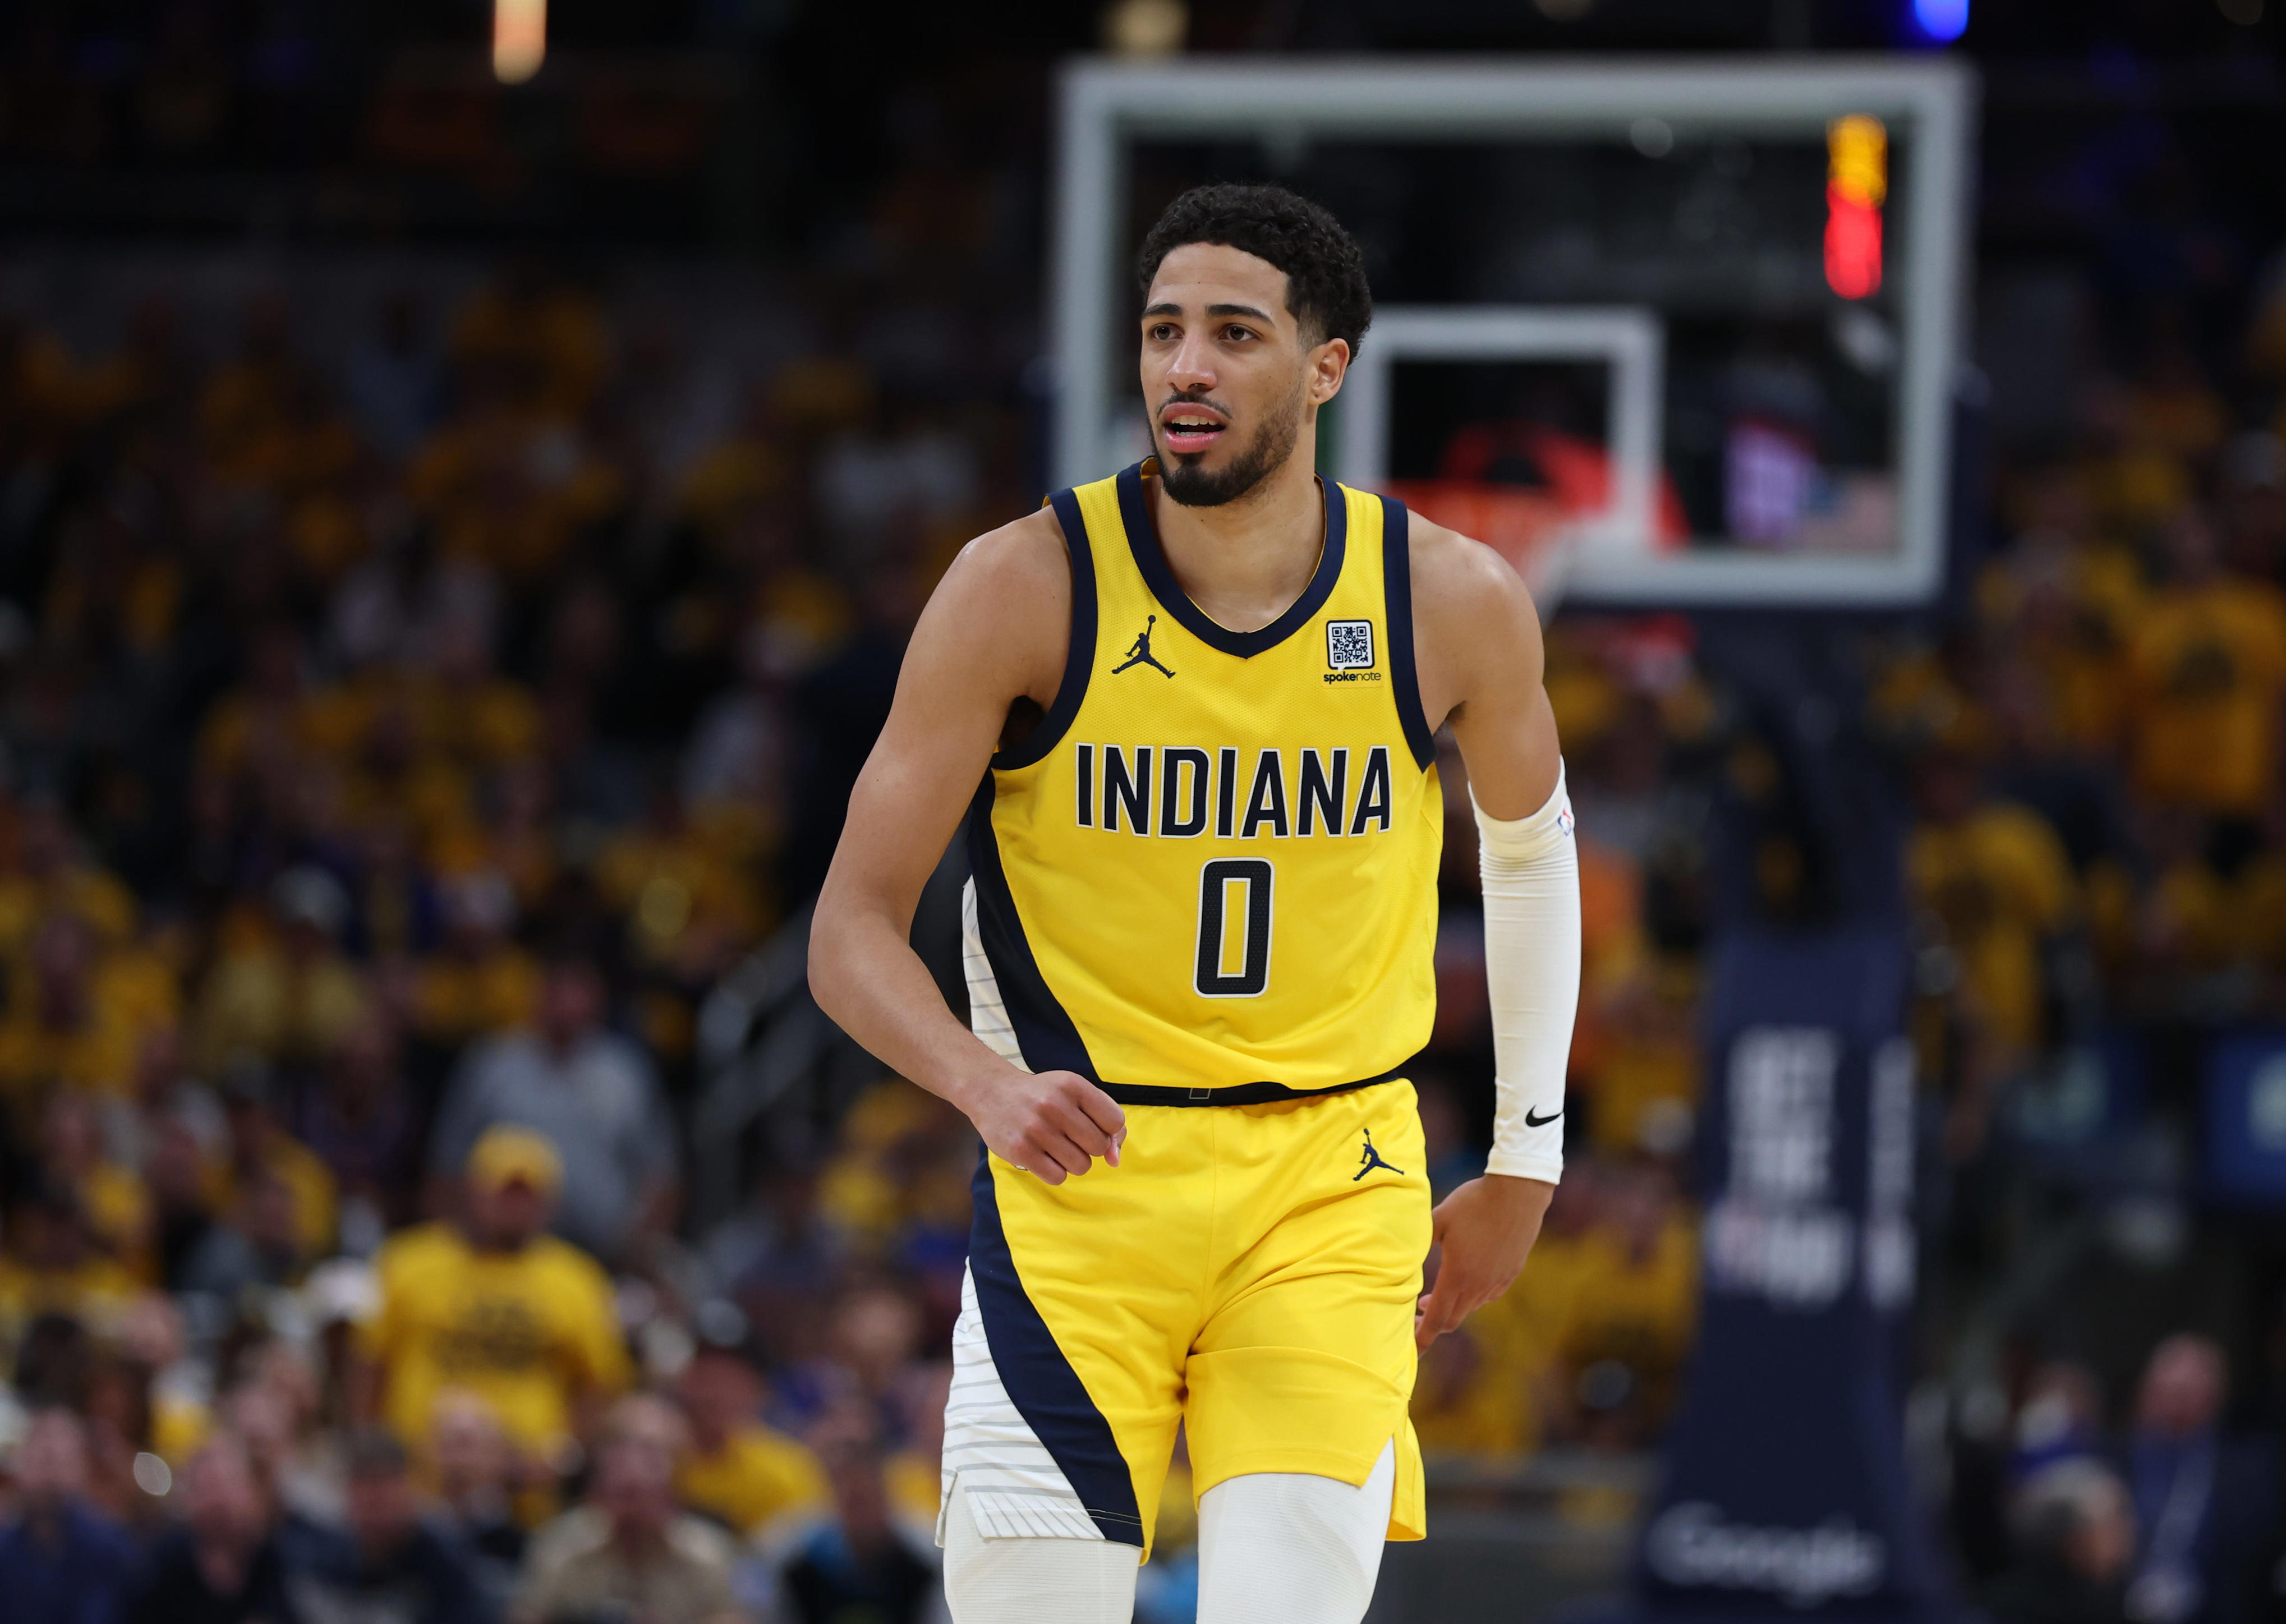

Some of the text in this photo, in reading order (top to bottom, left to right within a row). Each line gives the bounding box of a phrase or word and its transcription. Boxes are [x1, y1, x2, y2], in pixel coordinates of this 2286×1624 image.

[1323, 671, 1381, 684] spokenote
[1075, 742, 1391, 840] INDIANA
[1193, 857, 1275, 999] 0
